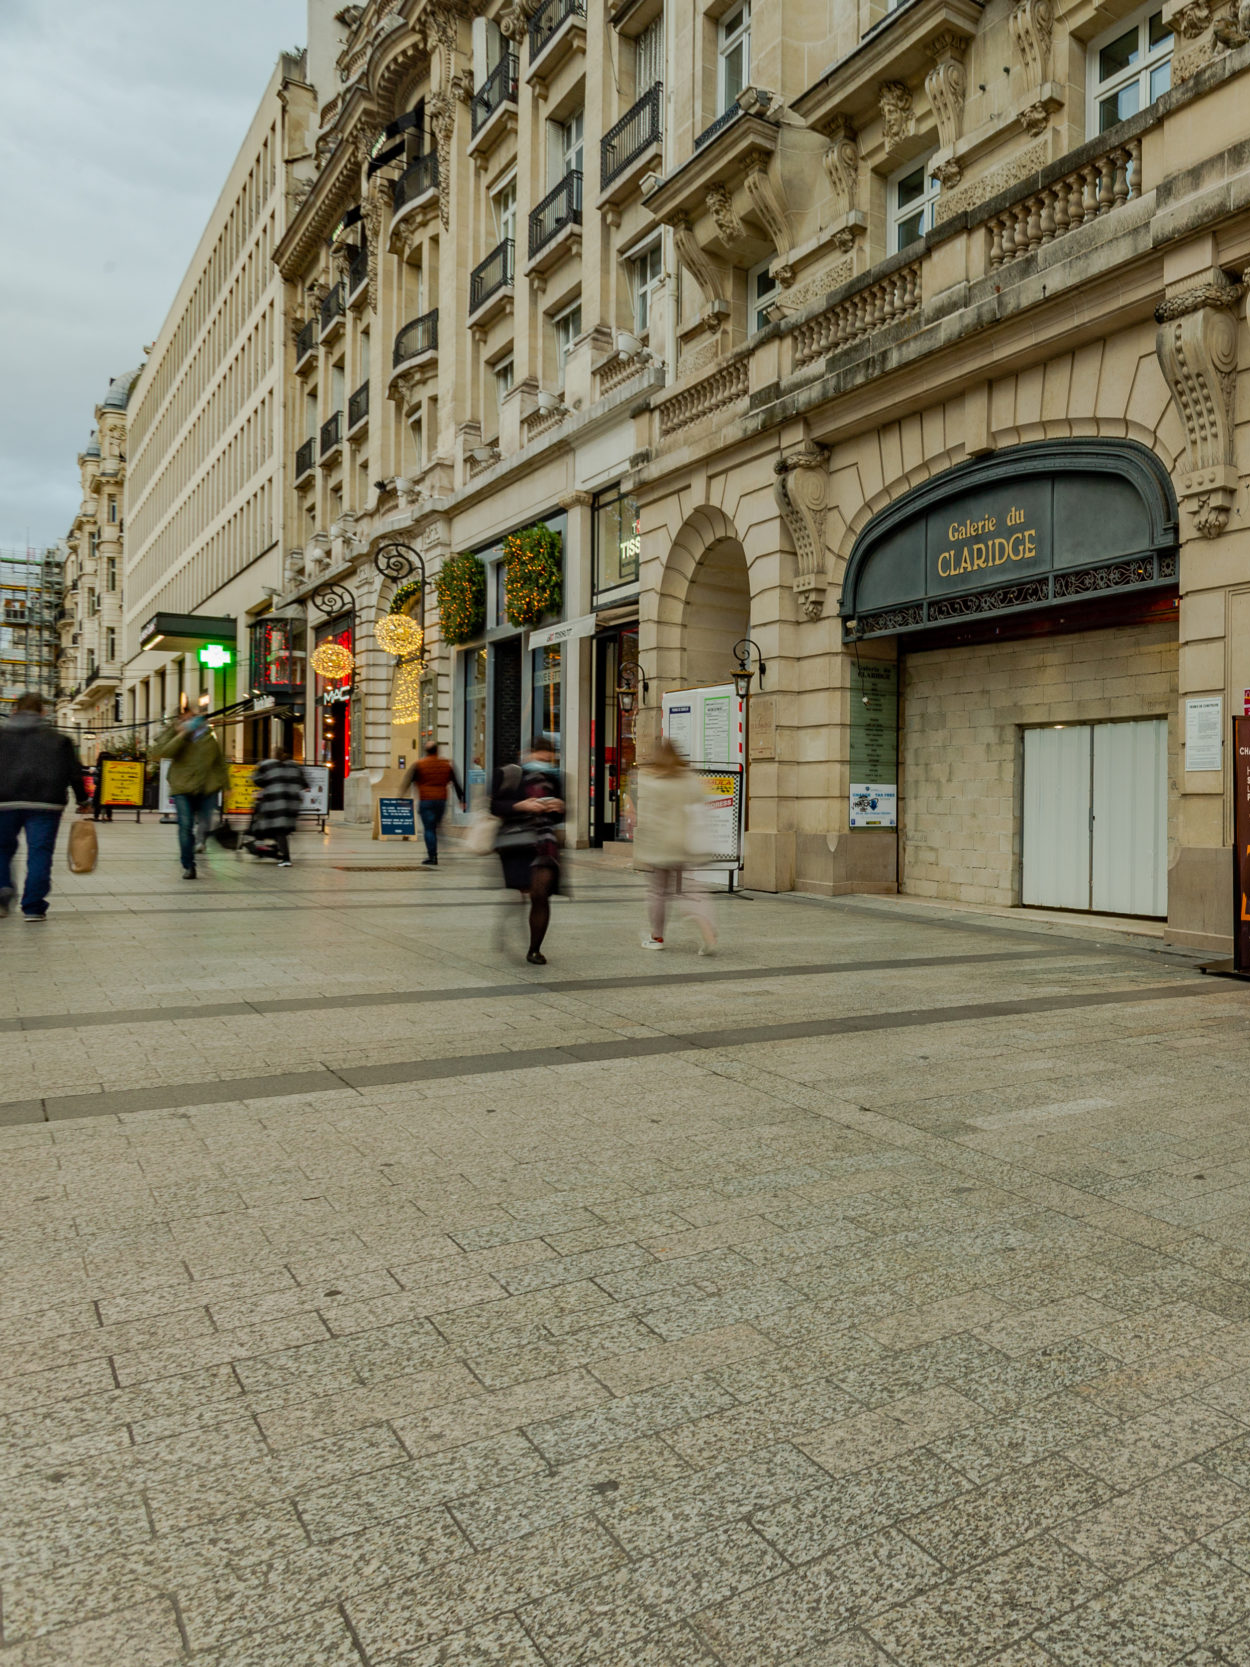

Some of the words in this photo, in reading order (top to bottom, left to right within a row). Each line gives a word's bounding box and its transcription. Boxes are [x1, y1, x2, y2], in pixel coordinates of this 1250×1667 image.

[949, 514, 996, 541] Galerie
[1007, 506, 1024, 526] du
[620, 536, 640, 559] TISS
[938, 529, 1036, 577] CLARIDGE
[324, 686, 350, 705] MAC
